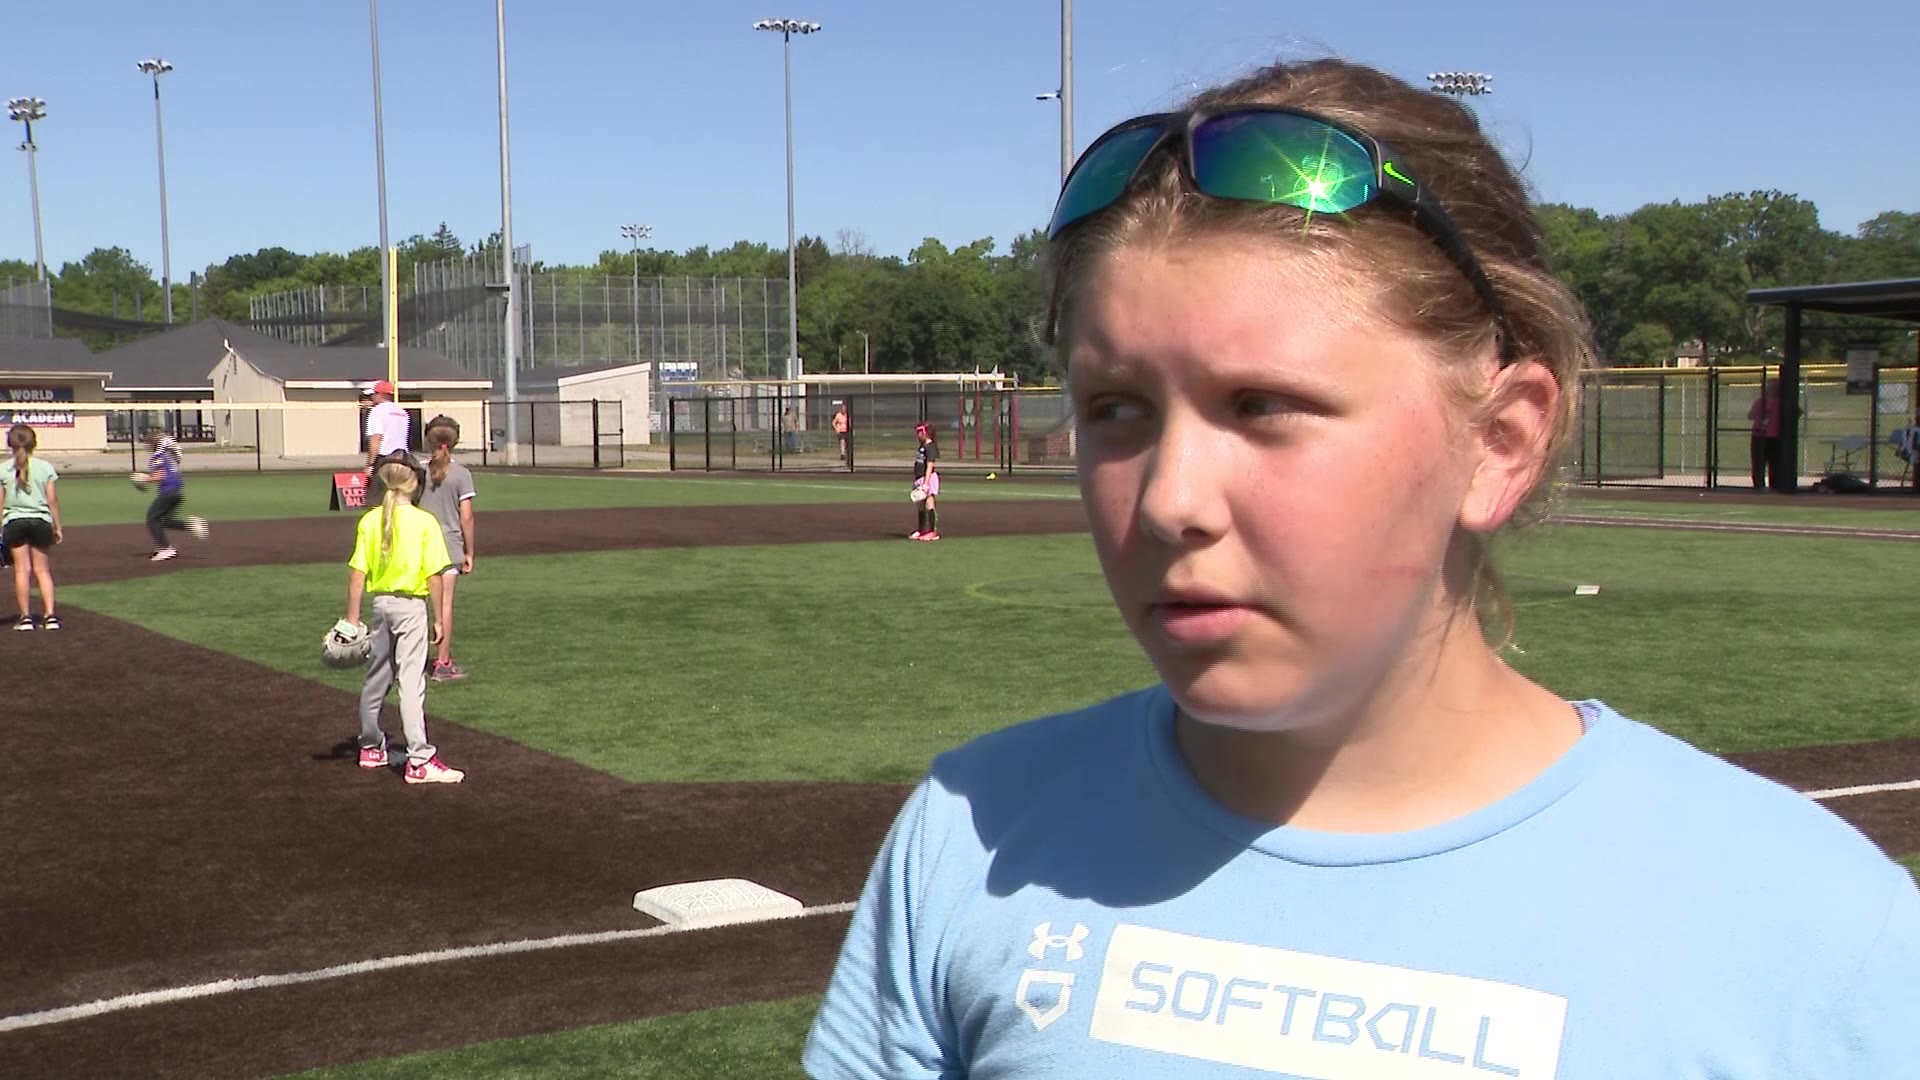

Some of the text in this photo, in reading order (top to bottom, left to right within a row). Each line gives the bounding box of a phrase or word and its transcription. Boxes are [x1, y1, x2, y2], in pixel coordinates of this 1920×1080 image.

[9, 389, 54, 401] WORLD
[12, 410, 74, 423] ACADEMY
[1124, 960, 1520, 1078] SOFTBALL
